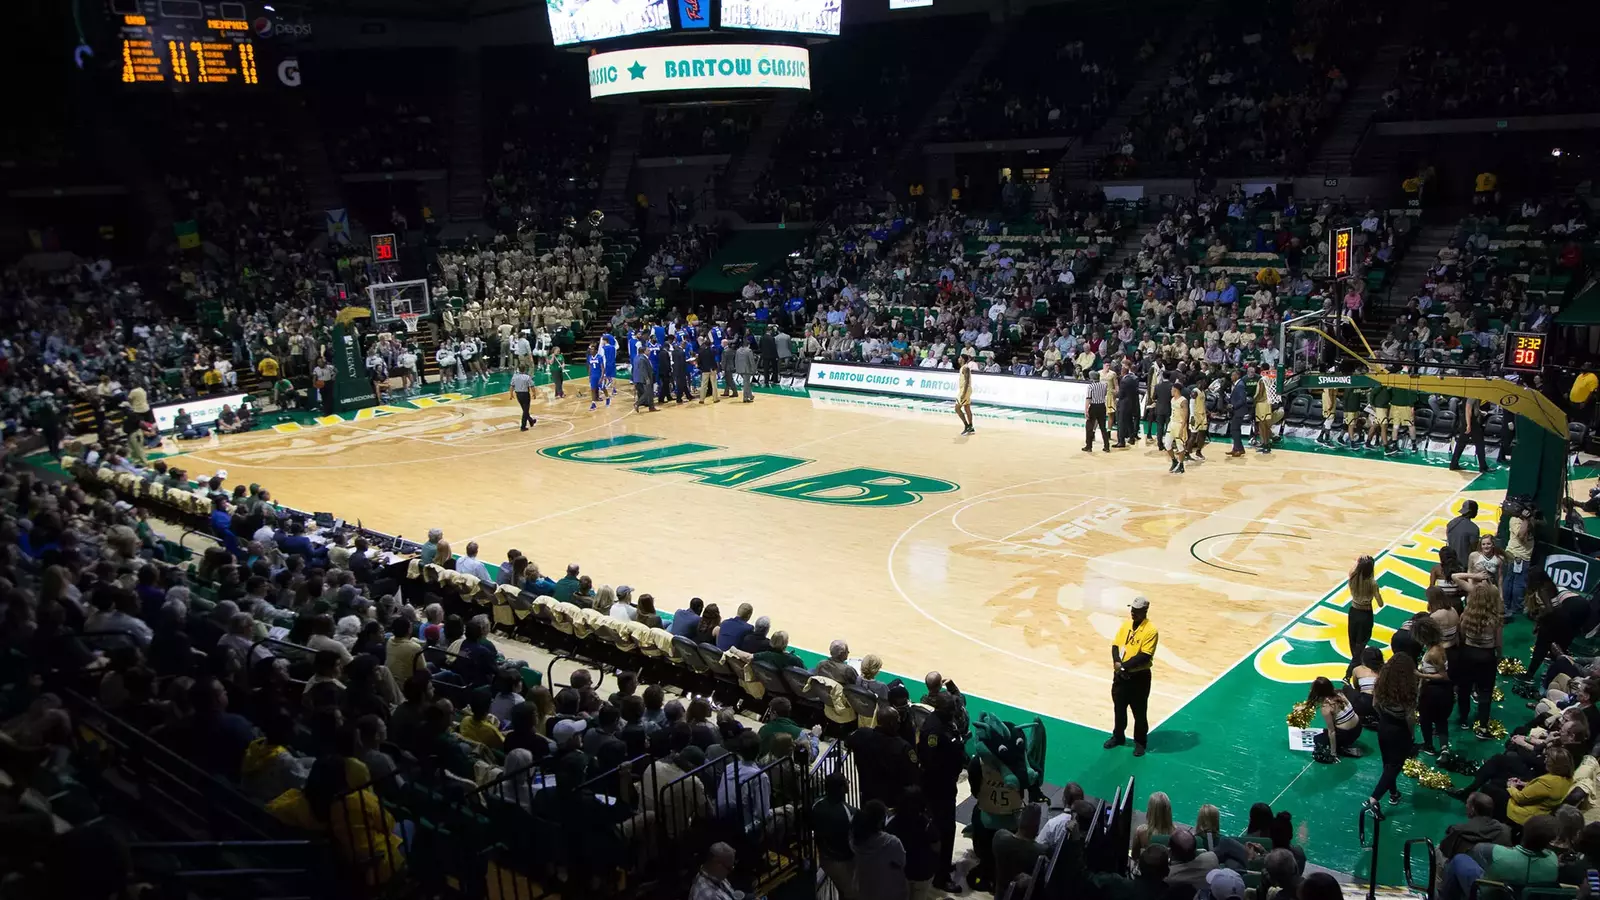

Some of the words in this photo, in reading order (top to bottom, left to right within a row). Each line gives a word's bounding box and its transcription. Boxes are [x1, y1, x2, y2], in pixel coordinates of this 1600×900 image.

[207, 19, 249, 30] MEMPHIS
[275, 23, 312, 36] pepsi
[277, 60, 301, 87] G
[664, 58, 752, 79] BARTOW
[758, 58, 807, 78] CLASSIC
[1325, 179, 1337, 187] 105
[376, 245, 392, 259] 30
[1518, 337, 1541, 350] 3:32
[345, 346, 357, 379] LEGACY
[1515, 349, 1536, 364] 30
[829, 370, 864, 384] BARTOW
[866, 374, 900, 387] CLASSIC
[1318, 375, 1352, 385] SPALDING
[536, 434, 960, 507] UAB
[990, 790, 1010, 806] 45
